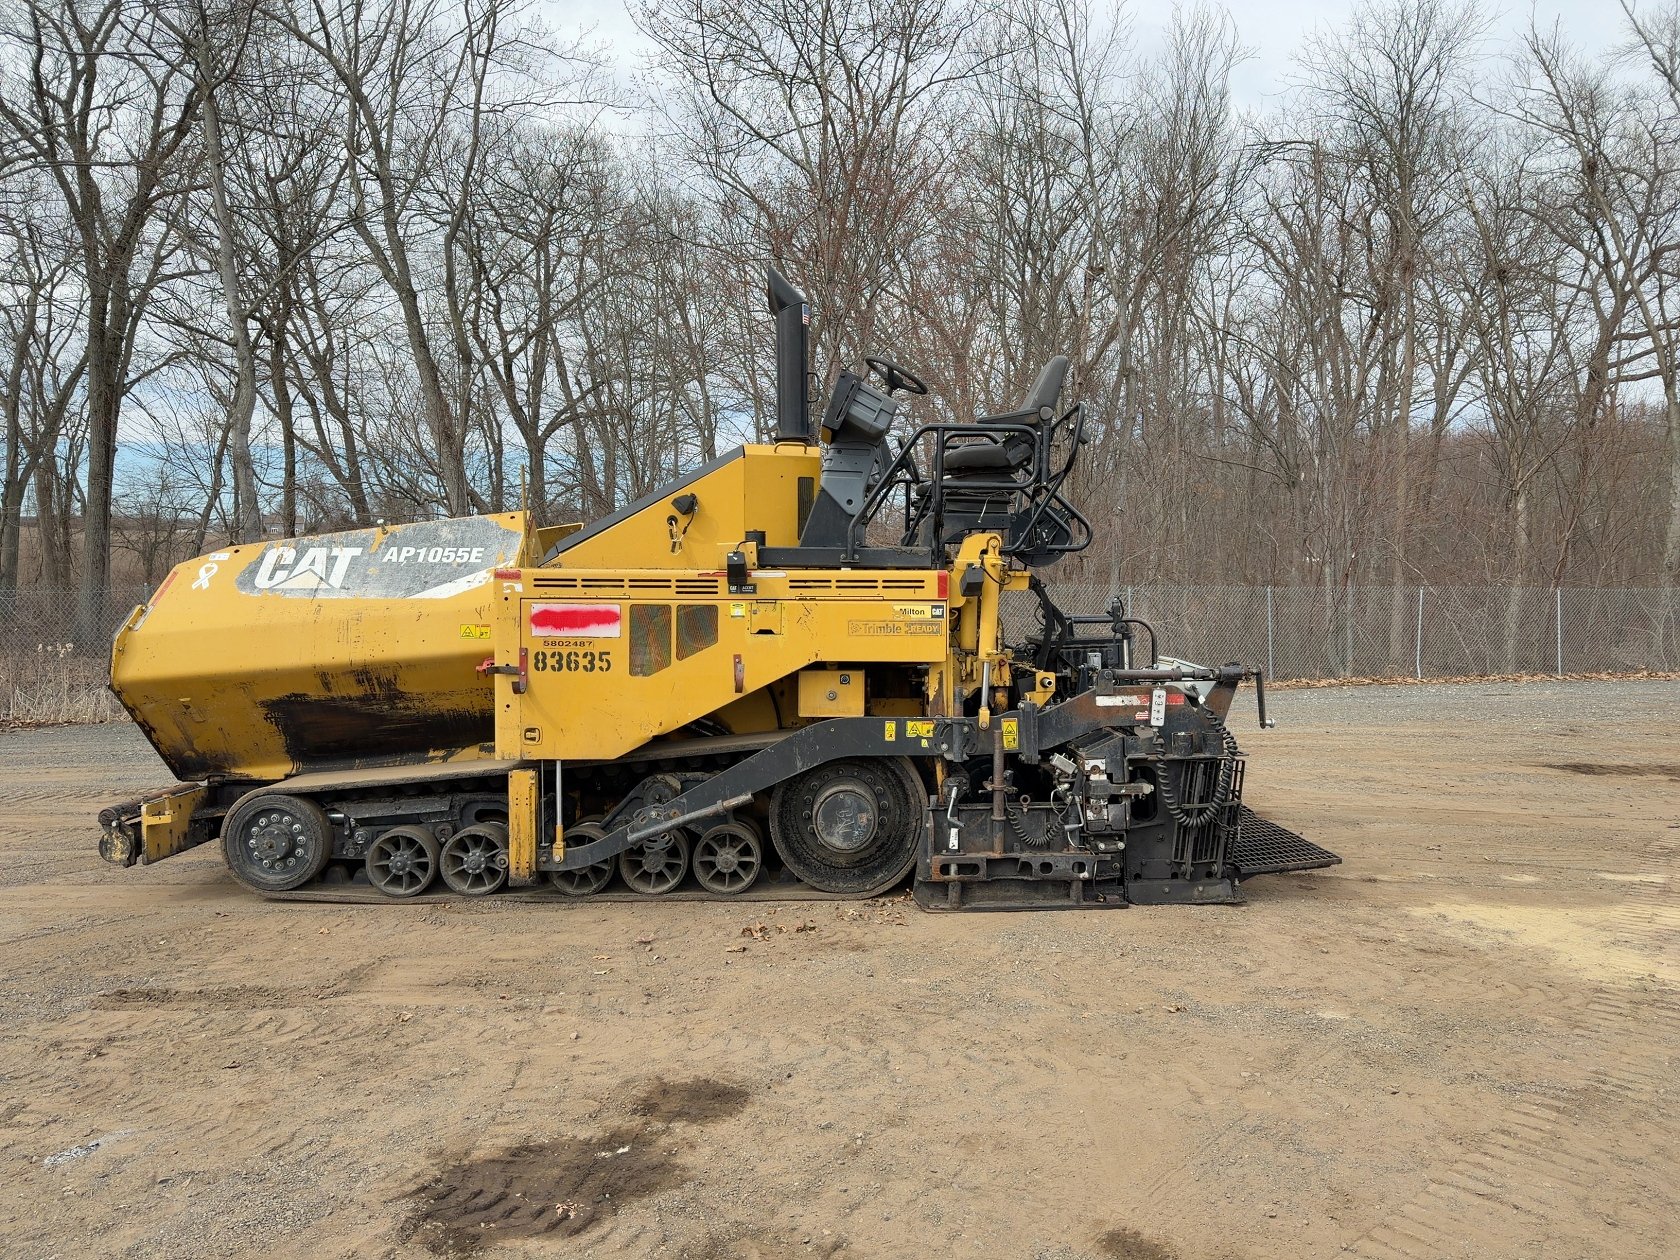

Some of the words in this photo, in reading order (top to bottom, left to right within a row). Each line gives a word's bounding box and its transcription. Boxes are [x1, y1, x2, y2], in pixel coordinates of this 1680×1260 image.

[382, 546, 485, 563] AP1055E
[254, 546, 363, 589] CAT
[932, 608, 943, 616] CAT
[862, 623, 901, 634] Trimble
[911, 625, 938, 633] READY
[534, 651, 612, 672] 83635
